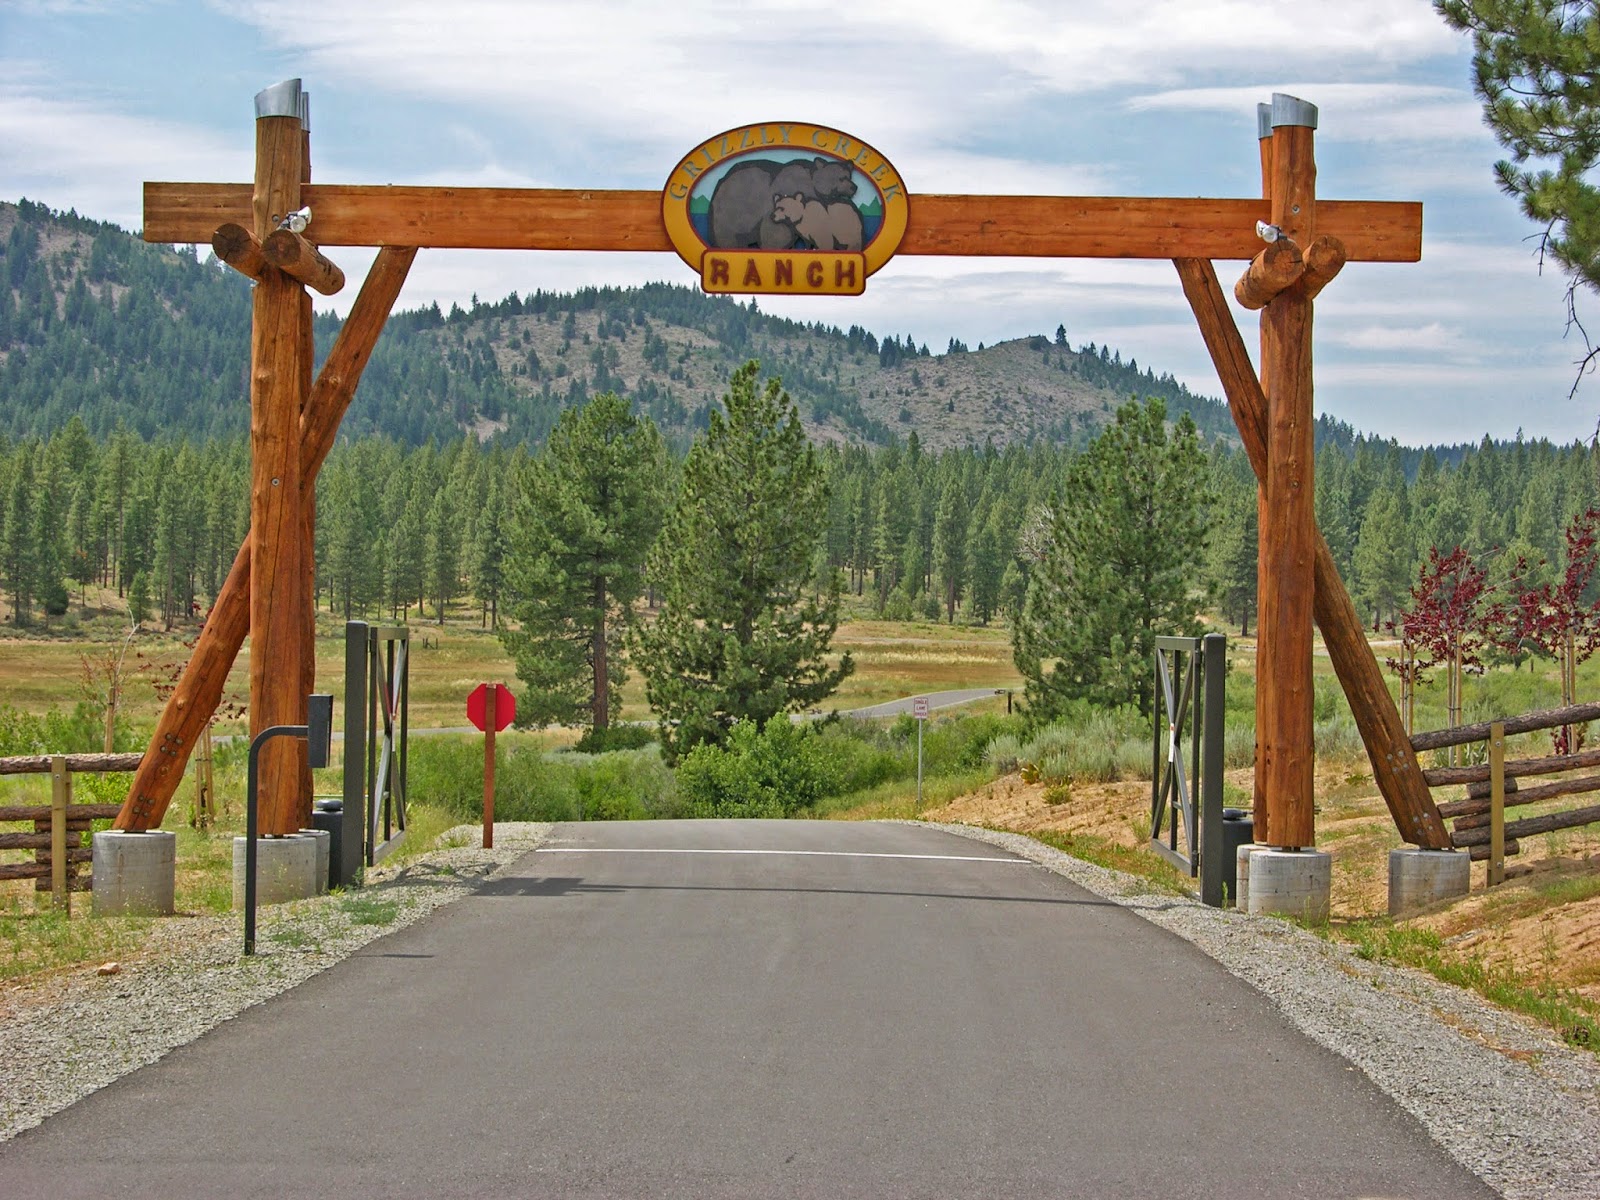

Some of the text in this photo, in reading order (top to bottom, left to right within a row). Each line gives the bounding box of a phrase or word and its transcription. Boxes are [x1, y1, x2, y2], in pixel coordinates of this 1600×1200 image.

[669, 125, 903, 203] GRIZZLY CREEK
[710, 257, 855, 287] RANCH
